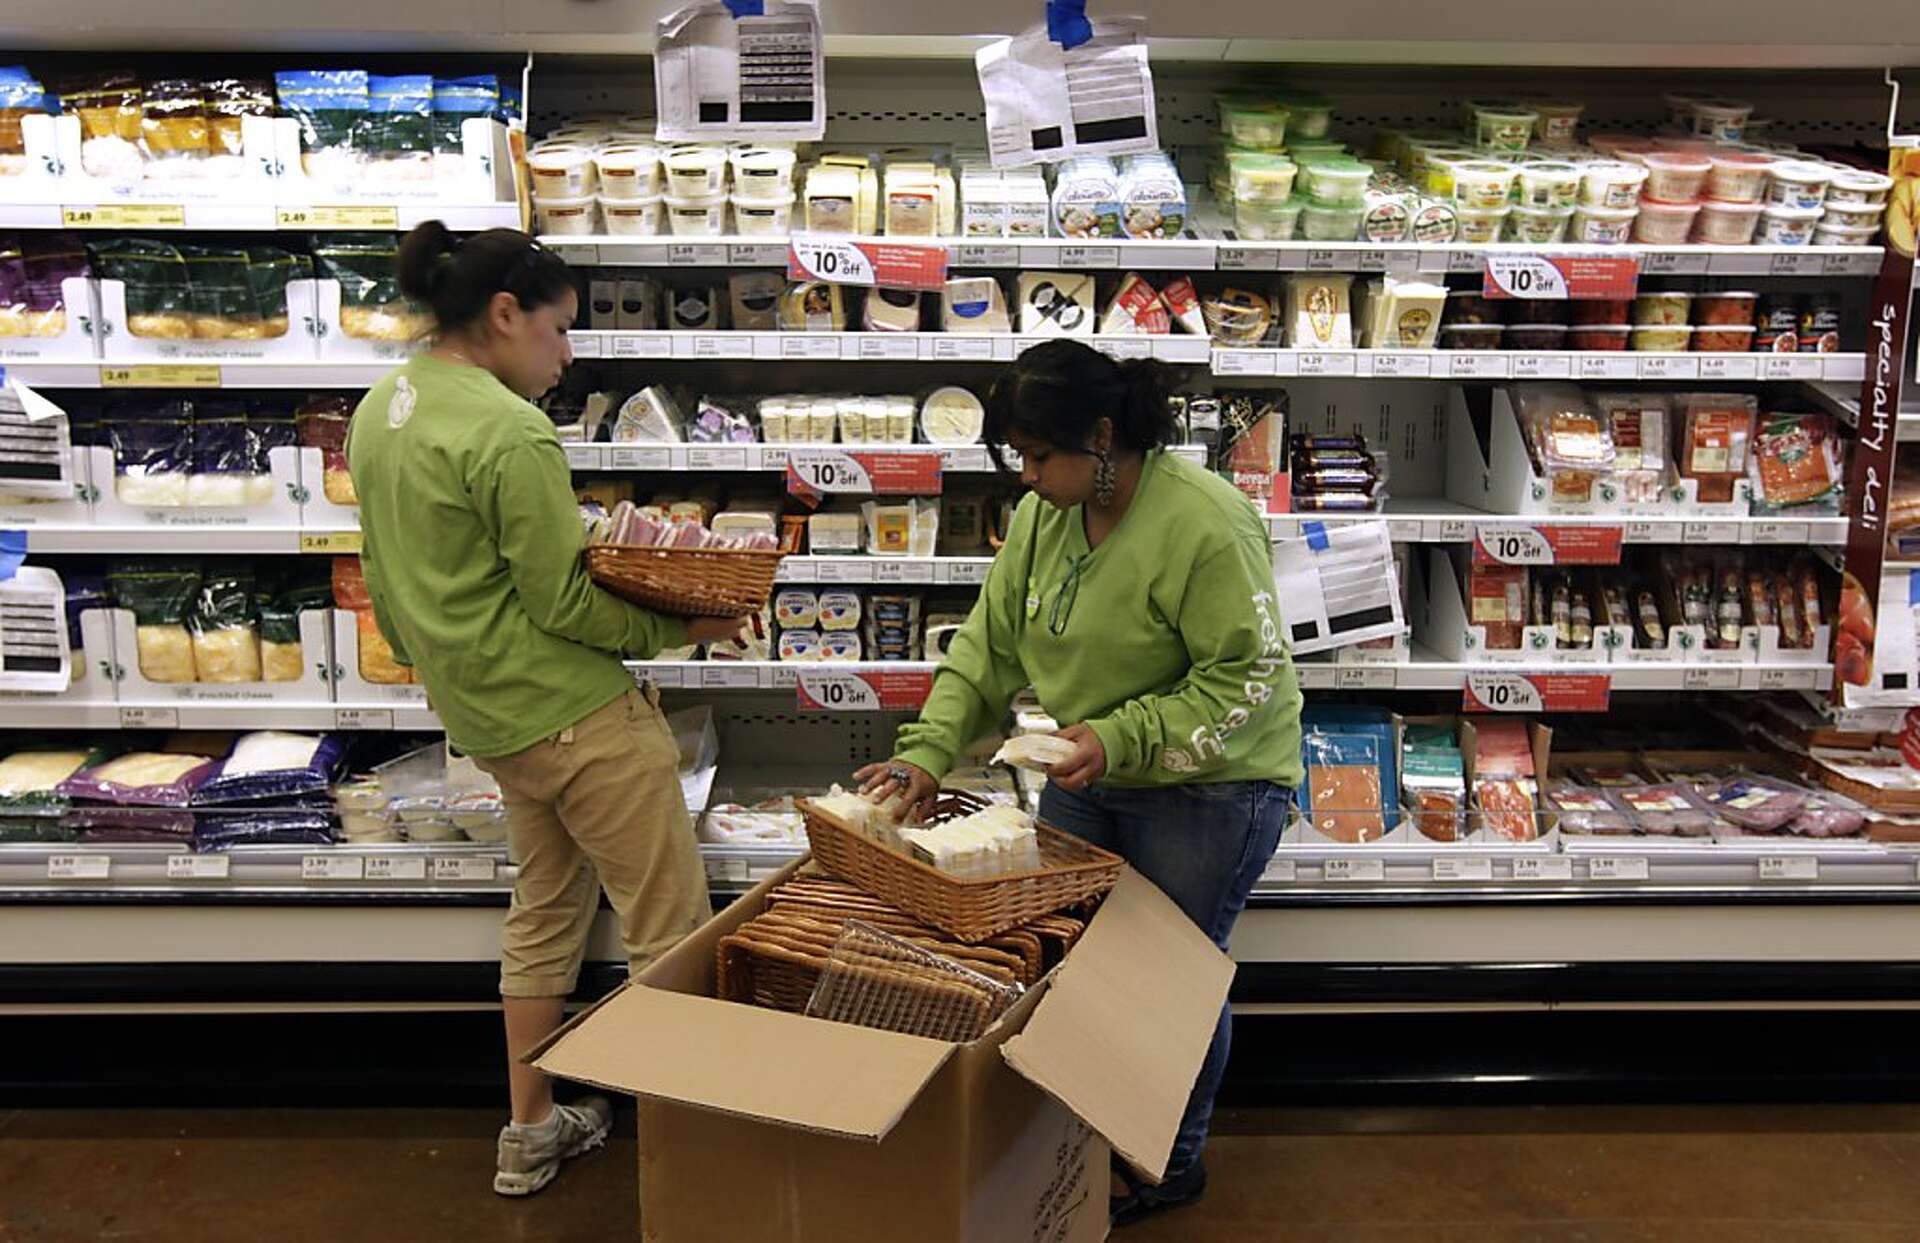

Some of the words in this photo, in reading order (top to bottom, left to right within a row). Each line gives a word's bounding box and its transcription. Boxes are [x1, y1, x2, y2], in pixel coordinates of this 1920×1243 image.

[842, 264, 861, 276] off
[1536, 280, 1554, 291] off
[1861, 303, 1897, 451] specialty
[840, 473, 858, 485] off
[1861, 466, 1881, 531] deli
[1524, 545, 1541, 558] off
[849, 691, 866, 703] off
[1513, 693, 1530, 705] off
